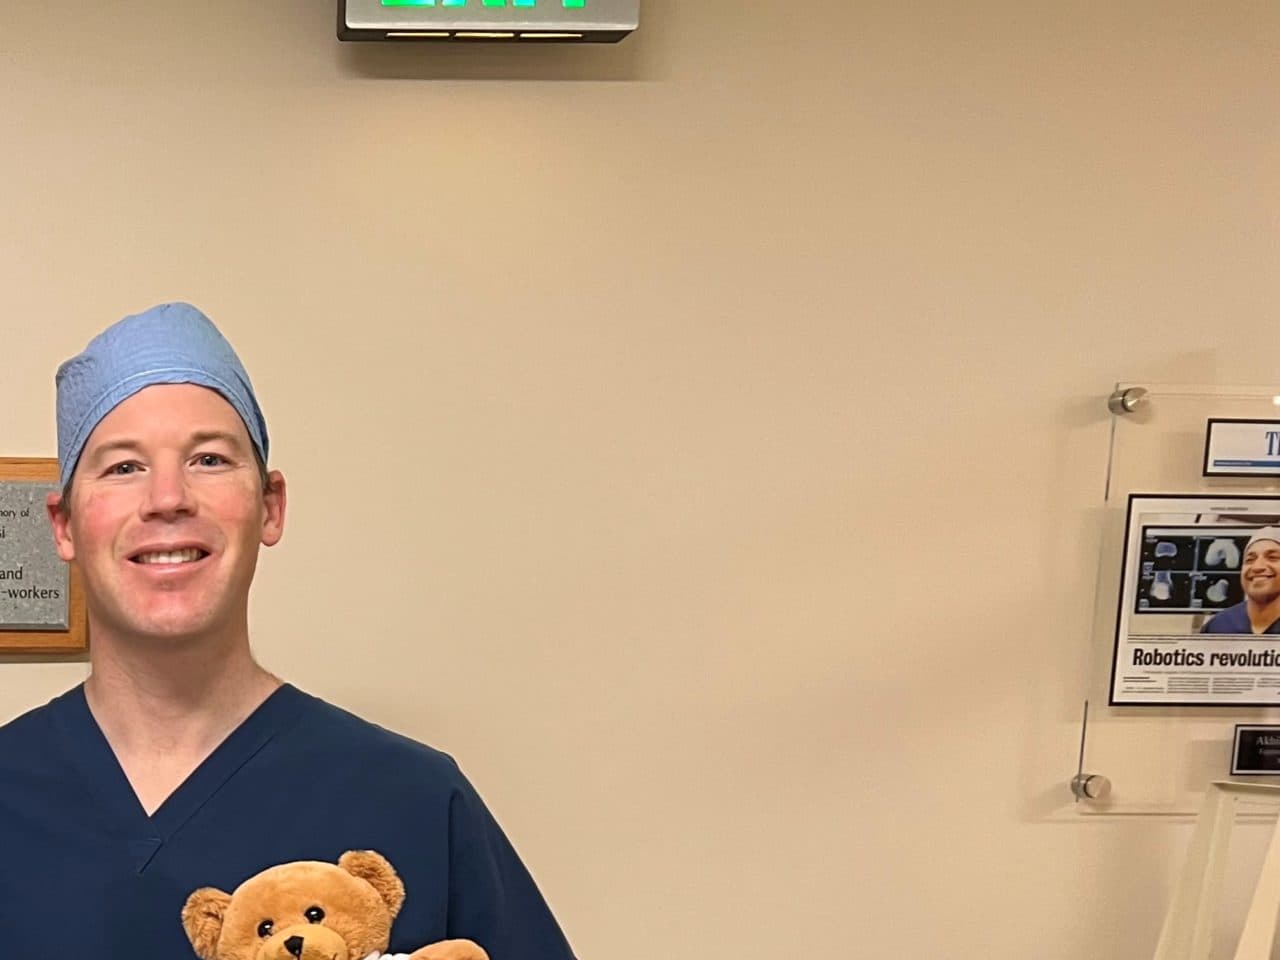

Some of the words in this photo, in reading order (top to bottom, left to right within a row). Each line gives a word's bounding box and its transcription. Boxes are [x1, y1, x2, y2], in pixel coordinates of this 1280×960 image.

[20, 507, 30, 517] of
[0, 566, 24, 580] and
[1132, 647, 1206, 666] Robotics
